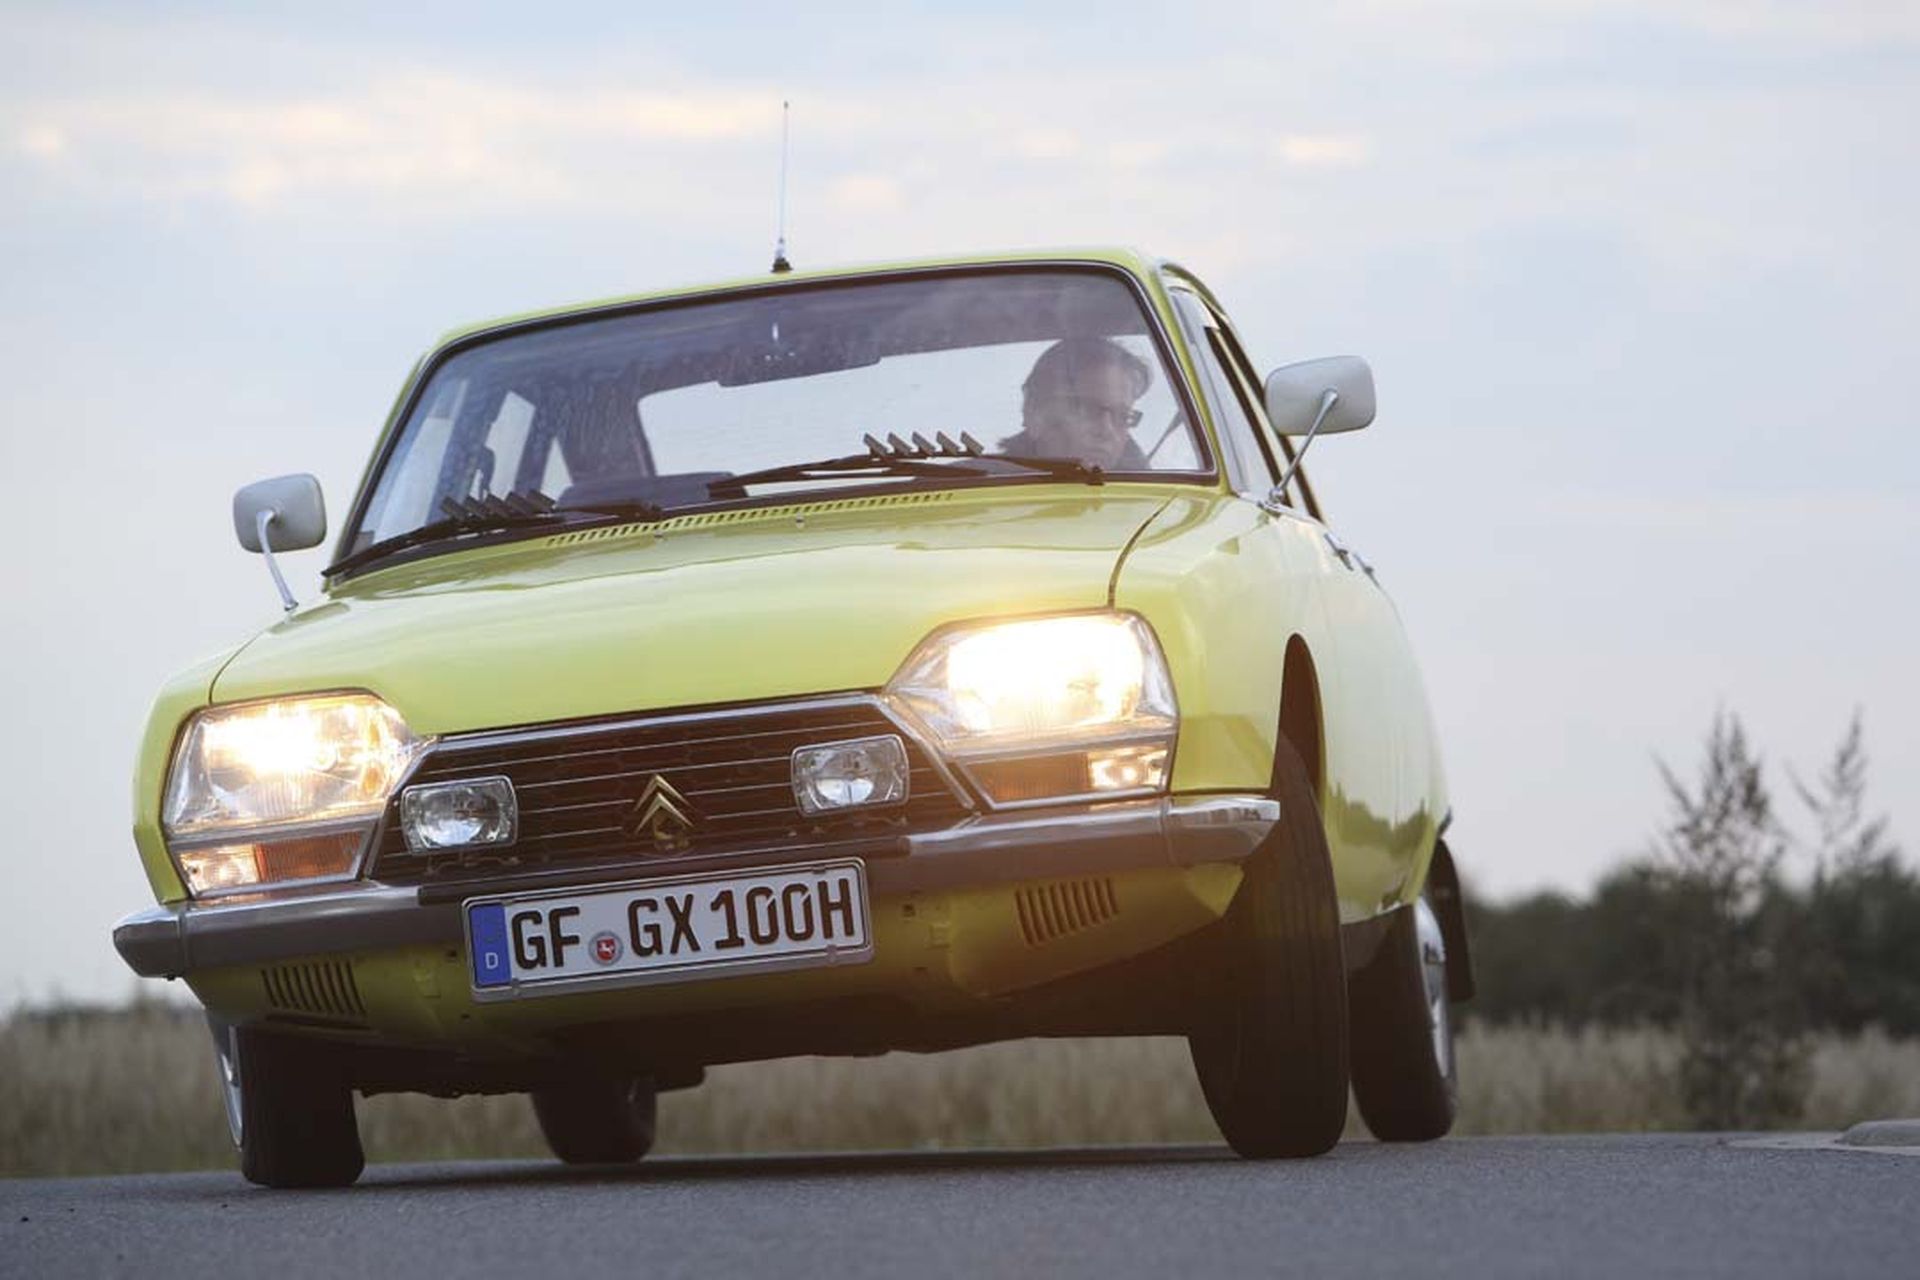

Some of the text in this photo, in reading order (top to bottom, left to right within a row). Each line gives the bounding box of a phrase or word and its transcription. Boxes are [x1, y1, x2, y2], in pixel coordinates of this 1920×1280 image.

[511, 878, 854, 970] GF GX 100H
[486, 953, 498, 970] D
